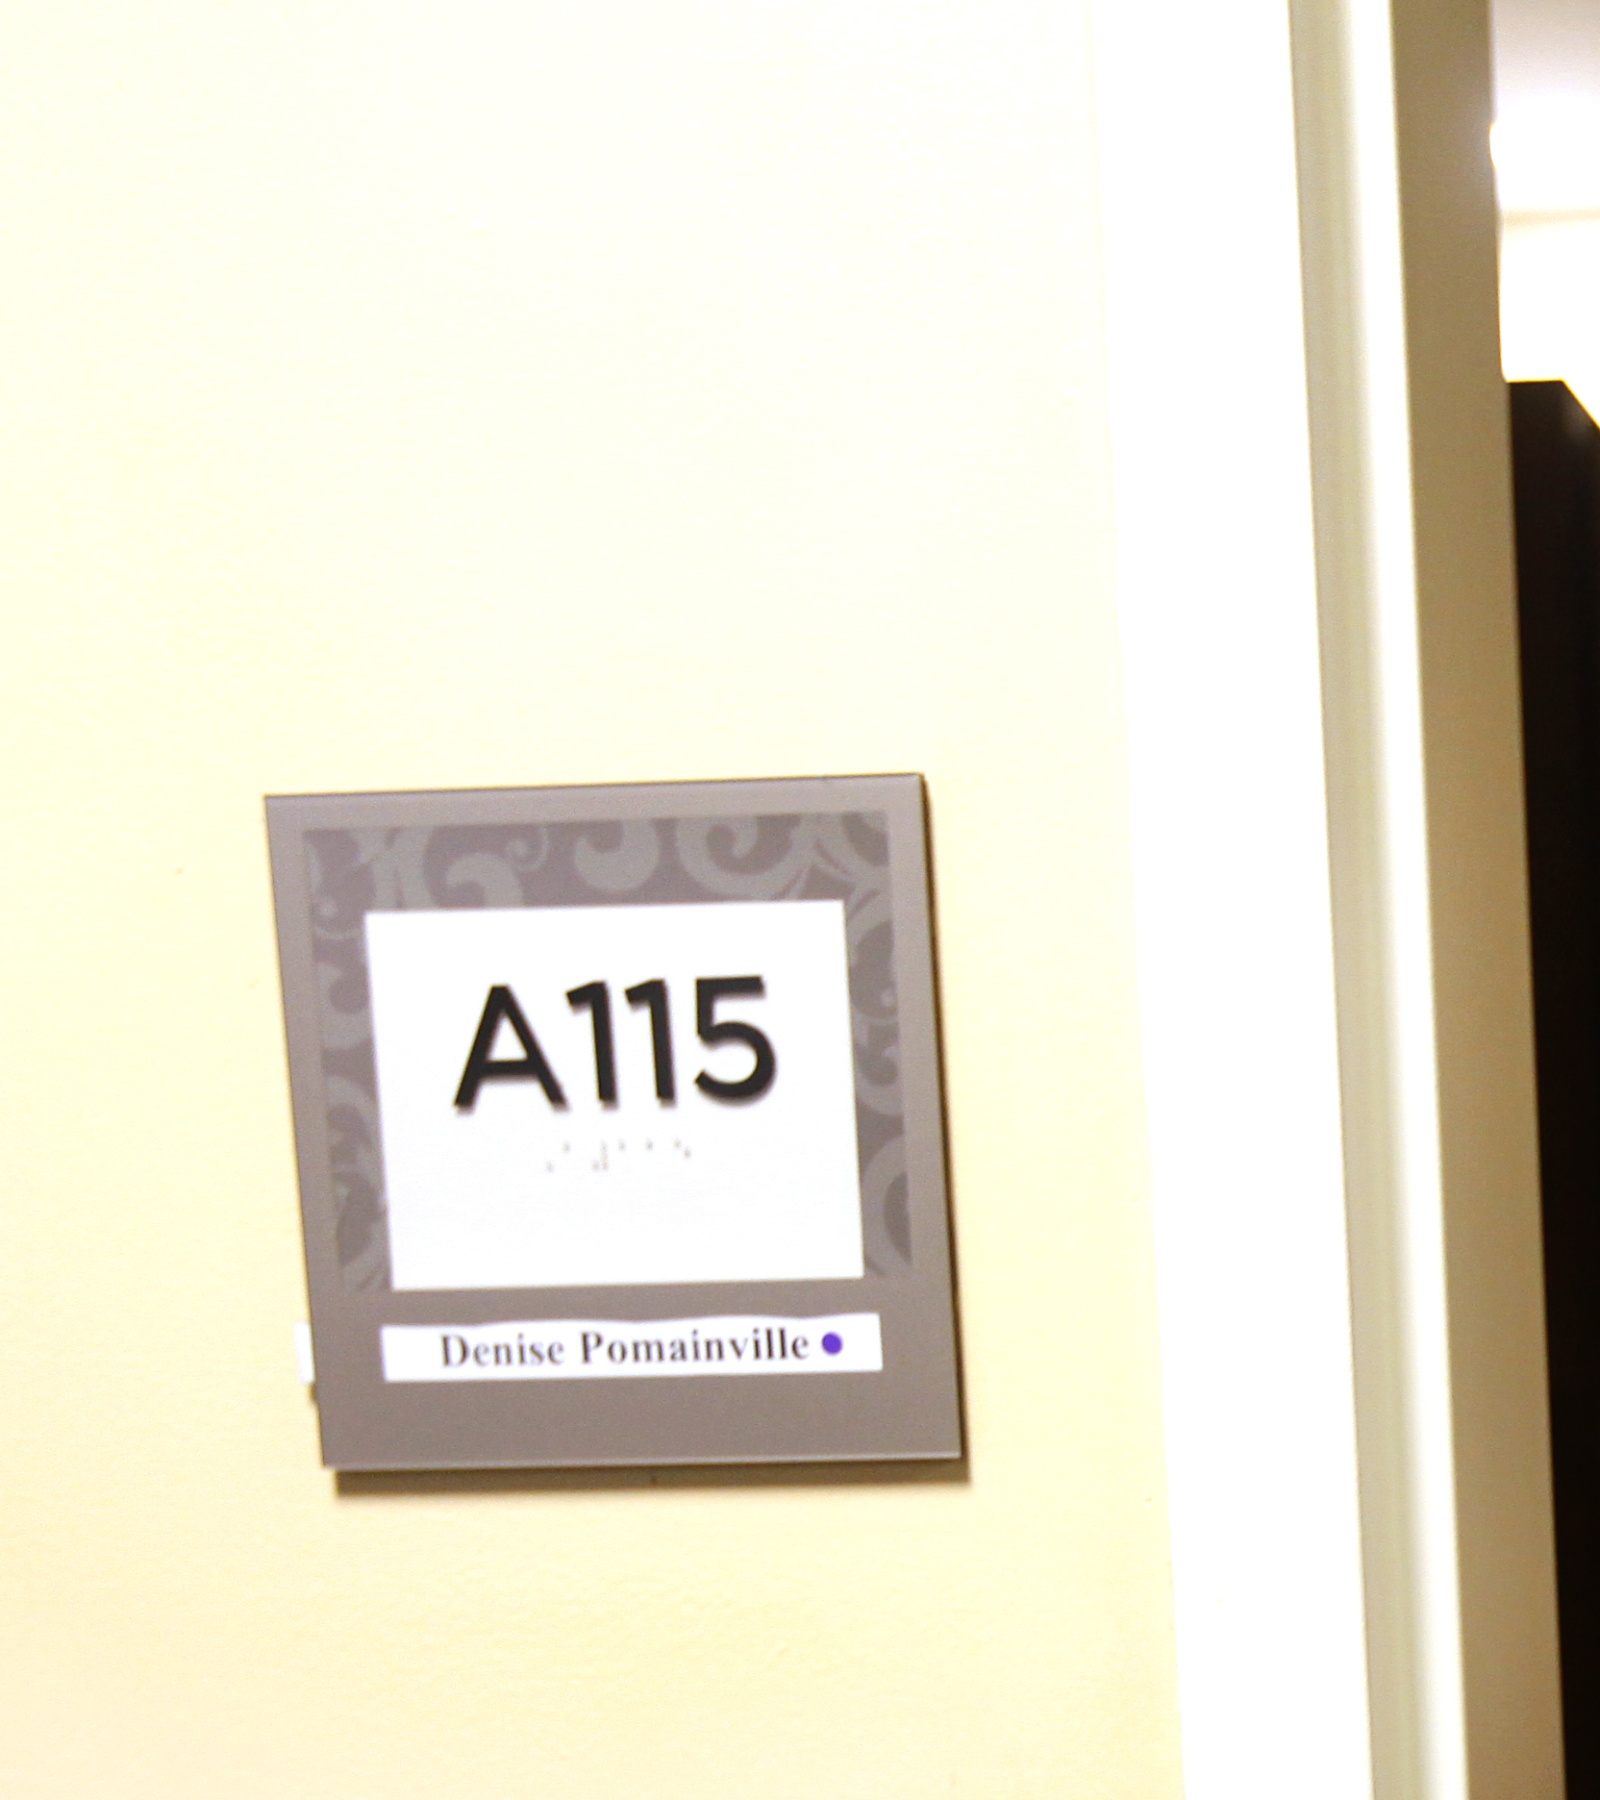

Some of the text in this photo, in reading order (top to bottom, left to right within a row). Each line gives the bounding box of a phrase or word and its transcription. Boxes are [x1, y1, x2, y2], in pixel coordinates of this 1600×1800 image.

[453, 975, 777, 1113] A115
[440, 1326, 810, 1368] Denise Pomainville
